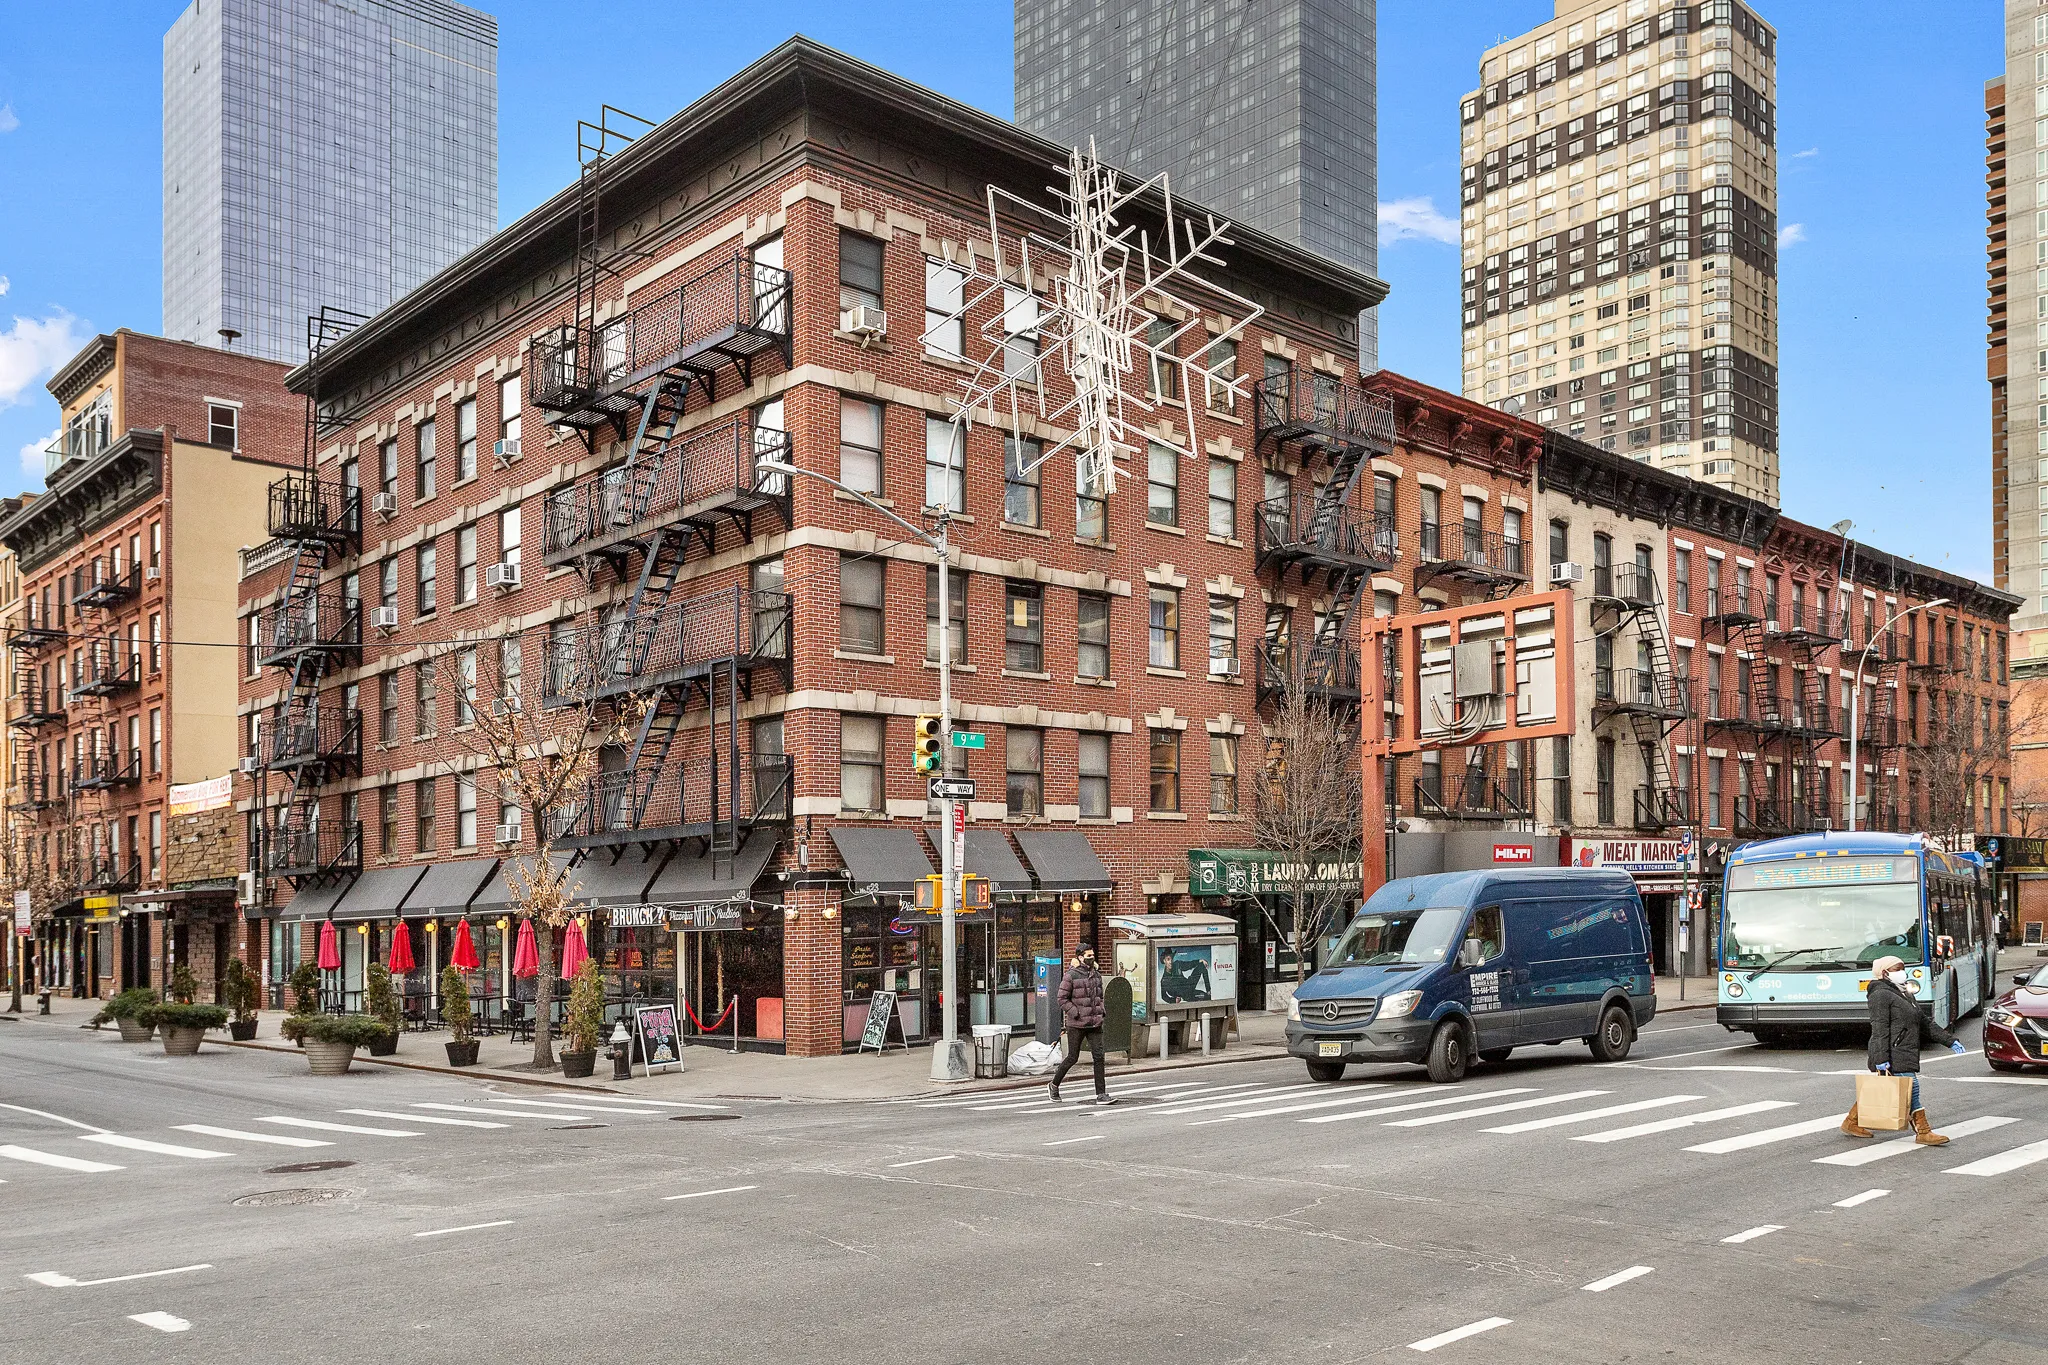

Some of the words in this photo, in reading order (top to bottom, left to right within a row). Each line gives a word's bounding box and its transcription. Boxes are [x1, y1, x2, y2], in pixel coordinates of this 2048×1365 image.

[961, 734, 966, 745] 9
[1495, 848, 1531, 859] HILTI
[1604, 843, 1637, 861] MEAT
[1642, 843, 1682, 861] MARKE
[1860, 864, 1886, 879] BUS
[1123, 921, 1136, 929] Phone
[1470, 972, 1498, 987] EMPIRE
[1758, 979, 1782, 989] 5510
